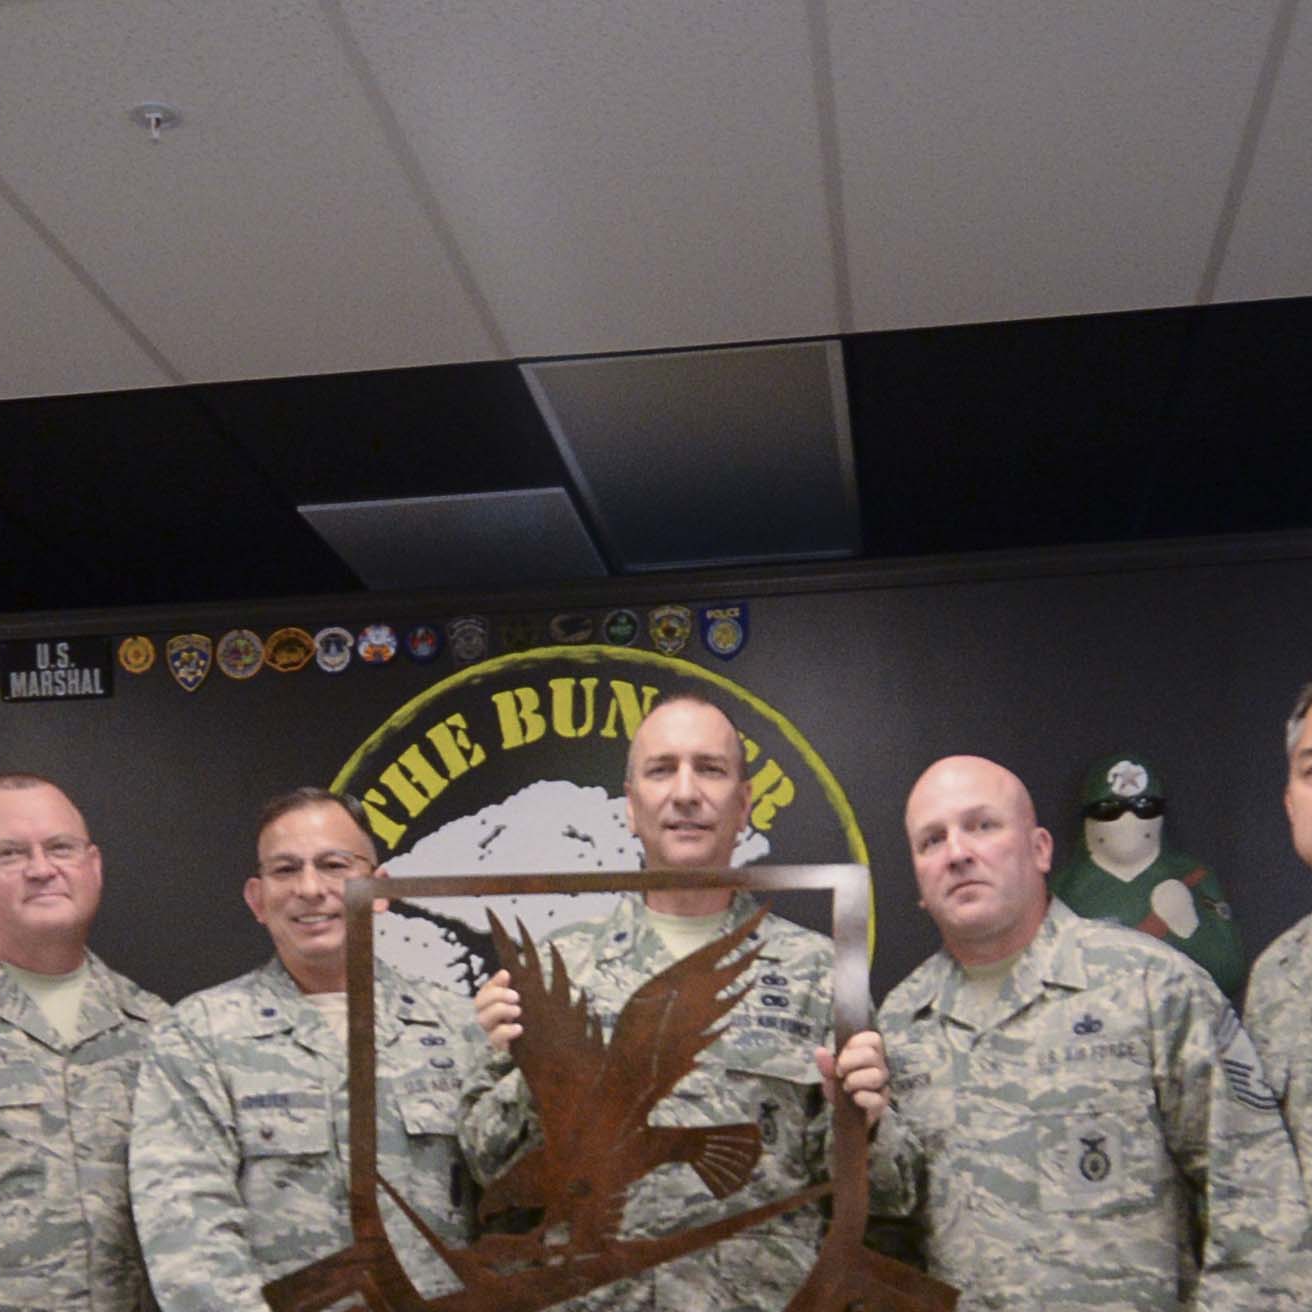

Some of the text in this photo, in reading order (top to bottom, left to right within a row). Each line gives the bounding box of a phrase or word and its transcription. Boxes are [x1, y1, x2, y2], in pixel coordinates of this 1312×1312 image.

[36, 642, 76, 670] U.S.
[9, 668, 104, 698] MARSHAL
[360, 677, 795, 851] THE BUNR
